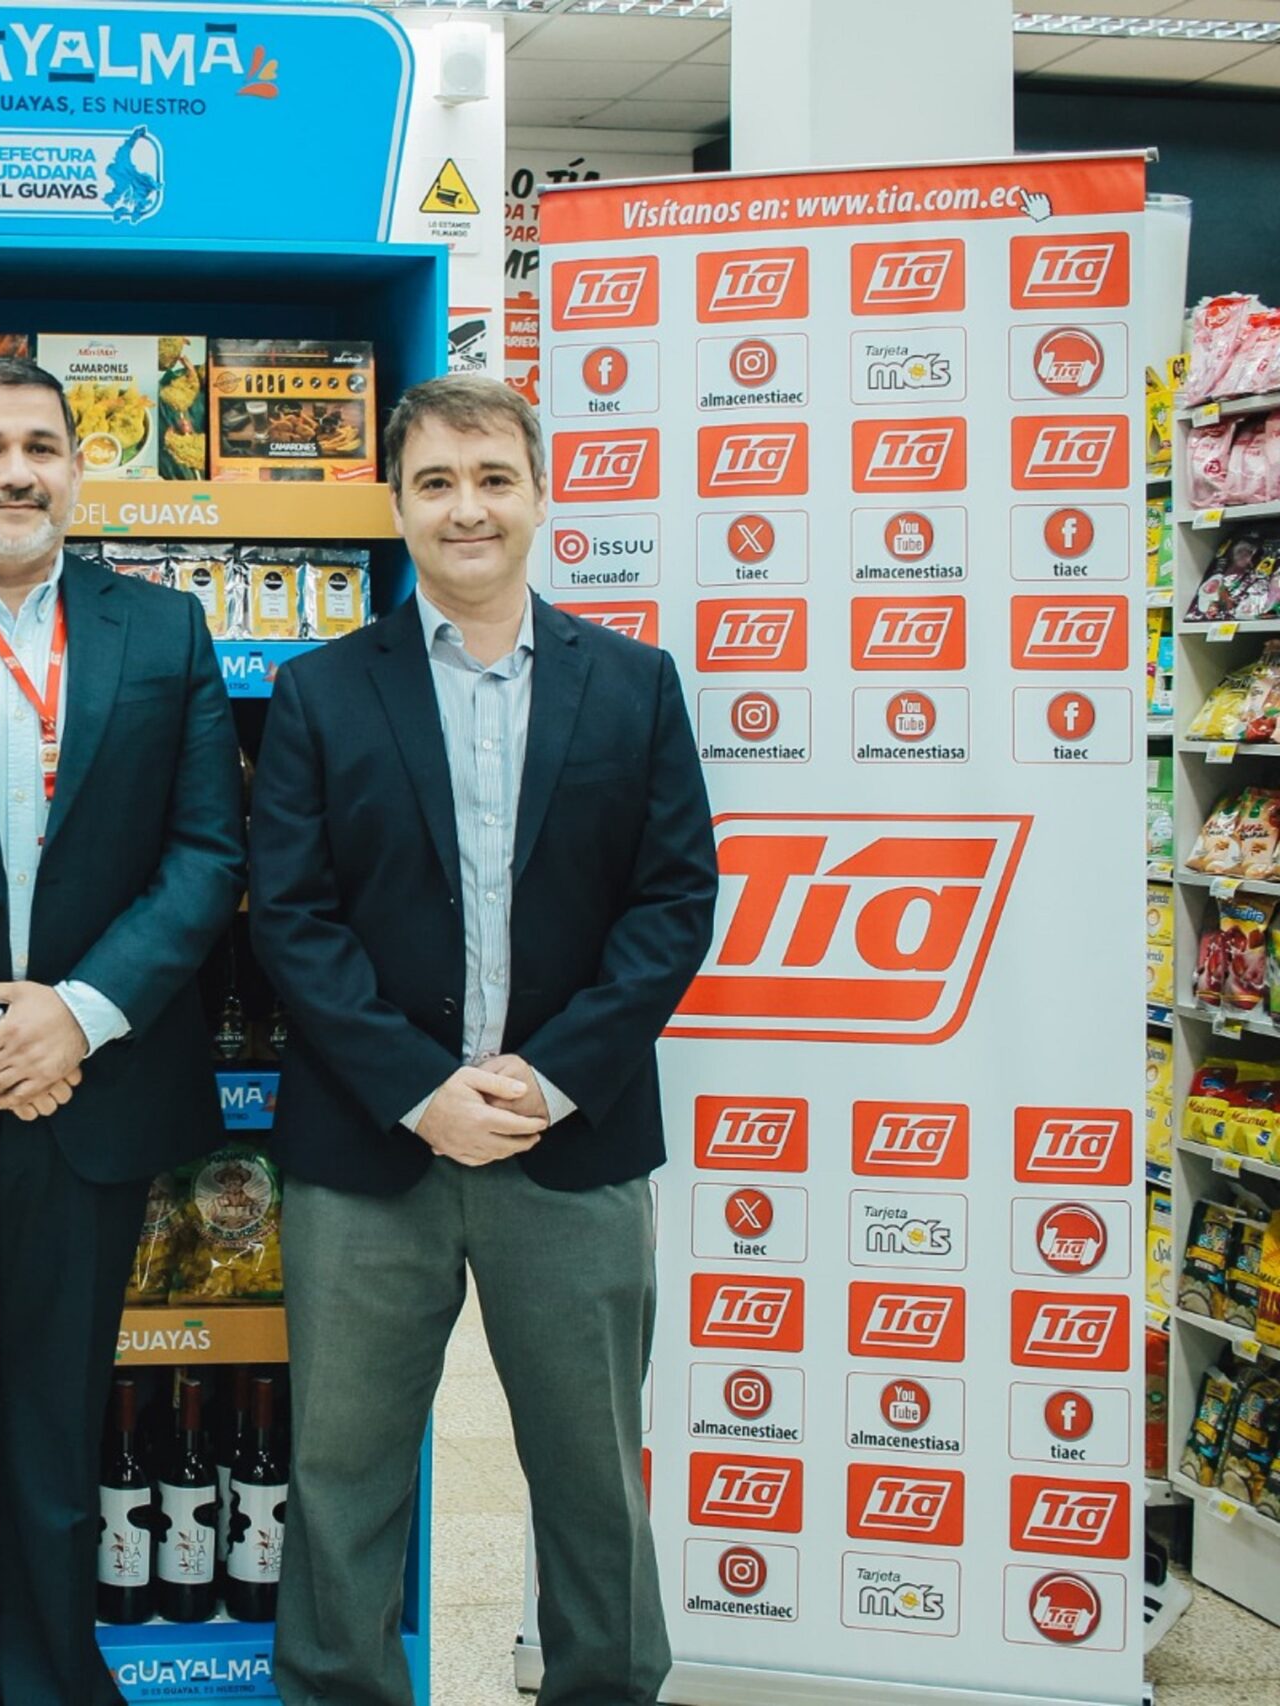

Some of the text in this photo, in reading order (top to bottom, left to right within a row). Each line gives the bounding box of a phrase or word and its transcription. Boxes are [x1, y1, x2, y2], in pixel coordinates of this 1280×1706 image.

[83, 97, 105, 113] ES
[113, 97, 207, 115] NUESTRO
[18, 184, 98, 199] GUAYAS
[623, 185, 1020, 229] Visítanos en: www.tia.com.ec
[865, 345, 908, 358] Tarjeta
[69, 364, 128, 374] CAMARONES
[588, 399, 620, 412] tiaec
[700, 390, 803, 408] almacenestiaec
[270, 443, 316, 451] CAMARONES
[72, 504, 110, 524] DEL
[120, 504, 219, 525] GUAYAS
[898, 519, 919, 533] You
[593, 538, 653, 555] issuu
[896, 537, 922, 551] Tube
[571, 569, 640, 584] tiaecuador
[736, 566, 769, 580] tiaec
[855, 564, 963, 580] almacenestiasa
[1053, 561, 1088, 577] tiaec
[901, 699, 921, 713] You
[898, 717, 924, 731] Tube
[701, 744, 806, 760] almacenestiaec
[857, 744, 965, 760] almacenestiasa
[1053, 746, 1088, 760] tiaec
[864, 1205, 907, 1220] Tarjeta
[733, 1240, 767, 1256] tiaec
[116, 1329, 211, 1352] GUAYAS
[895, 1386, 915, 1401] You
[892, 1405, 918, 1421] Tube
[692, 1420, 798, 1440] almacenestiaec
[851, 1430, 960, 1452] almacenestiasa
[1051, 1444, 1086, 1461] tiaec
[857, 1568, 901, 1584] Tarjeta
[687, 1595, 793, 1618] almacenestiaec
[118, 1657, 271, 1685] GUAYALMA
